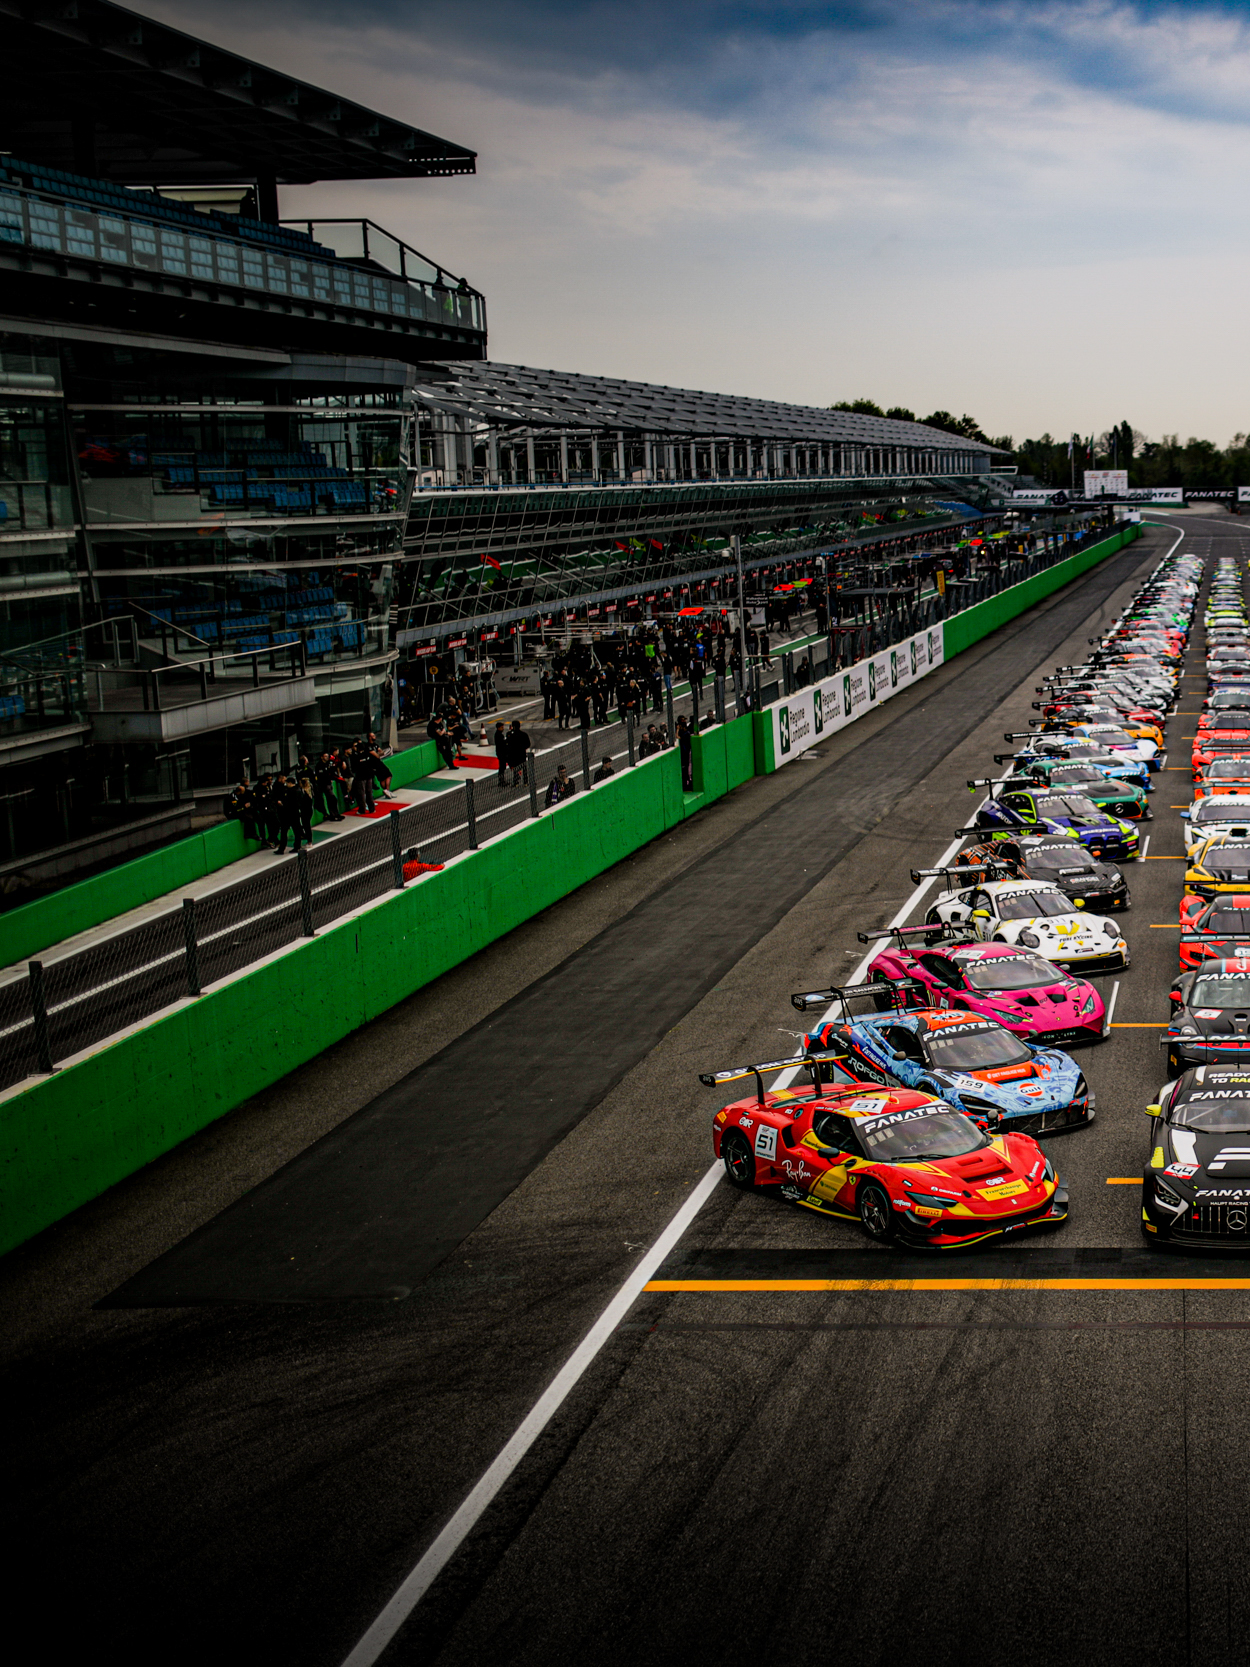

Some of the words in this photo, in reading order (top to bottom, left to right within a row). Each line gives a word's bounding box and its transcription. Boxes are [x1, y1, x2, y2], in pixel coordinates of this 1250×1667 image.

[1185, 490, 1236, 498] FANATEC
[850, 676, 863, 693] Regione
[822, 690, 836, 708] Regione
[790, 706, 805, 726] Regione
[823, 704, 841, 724] Lombardia
[791, 722, 810, 743] Lombardia
[1052, 764, 1094, 773] FANATEC
[1037, 794, 1084, 804] FANATEC
[1025, 844, 1080, 854] FANATEC
[998, 888, 1060, 901] FANATEC
[966, 954, 1037, 969] FANATEC
[923, 1022, 999, 1042] FANATEC
[848, 1056, 885, 1085] ROFGO
[960, 1079, 984, 1089] 159
[1020, 1086, 1042, 1094] Gulf
[864, 1106, 950, 1134] FANATEC
[757, 1134, 774, 1151] 51
[1170, 1165, 1194, 1176] 44
